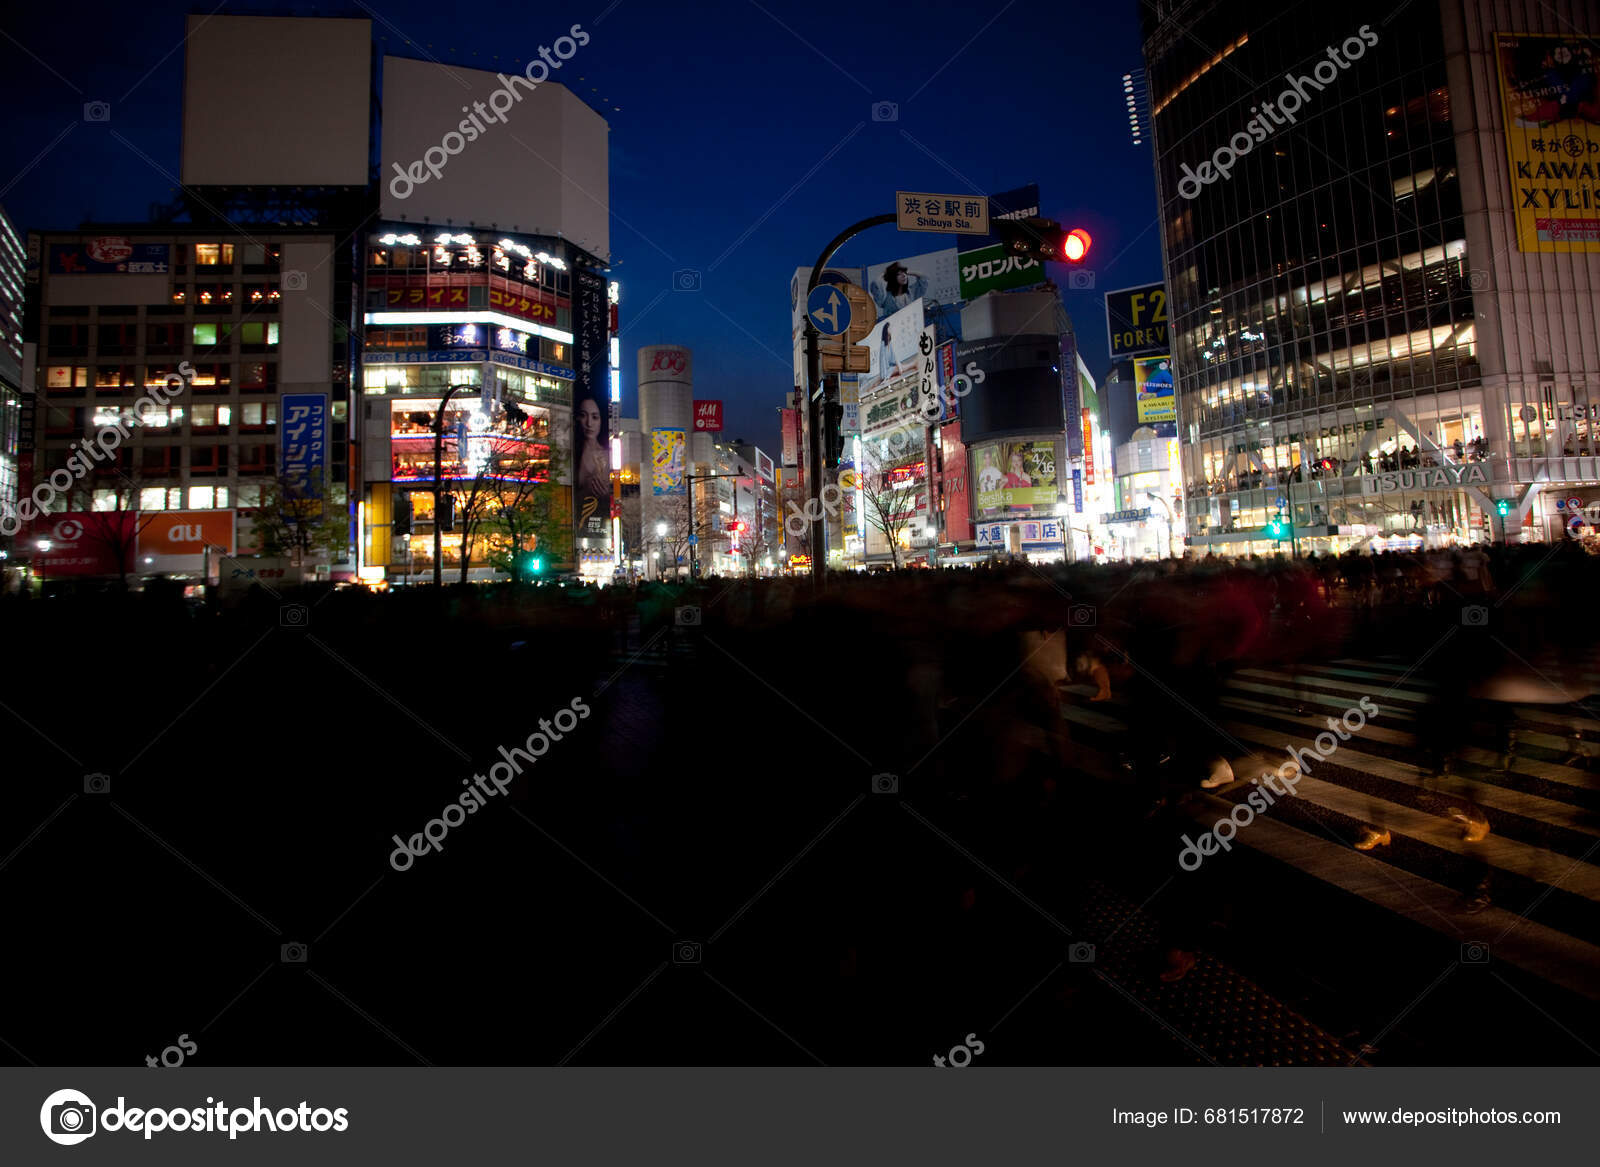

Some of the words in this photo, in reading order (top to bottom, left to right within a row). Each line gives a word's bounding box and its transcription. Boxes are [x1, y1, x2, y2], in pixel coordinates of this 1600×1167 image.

[1517, 161, 1600, 179] KAWA
[905, 198, 981, 218] 渋谷駅前
[917, 217, 952, 228] Shibuya
[388, 289, 466, 304] プライス
[490, 290, 554, 319] コンタクト
[1130, 289, 1168, 327] F2
[1113, 326, 1167, 351] FOREV
[698, 403, 717, 417] H&M
[311, 405, 323, 463] コンタクト
[1319, 418, 1385, 439] COFFEE
[1031, 453, 1055, 473] 4/16
[1366, 466, 1487, 493] TSUTAYA
[168, 524, 202, 542] au
